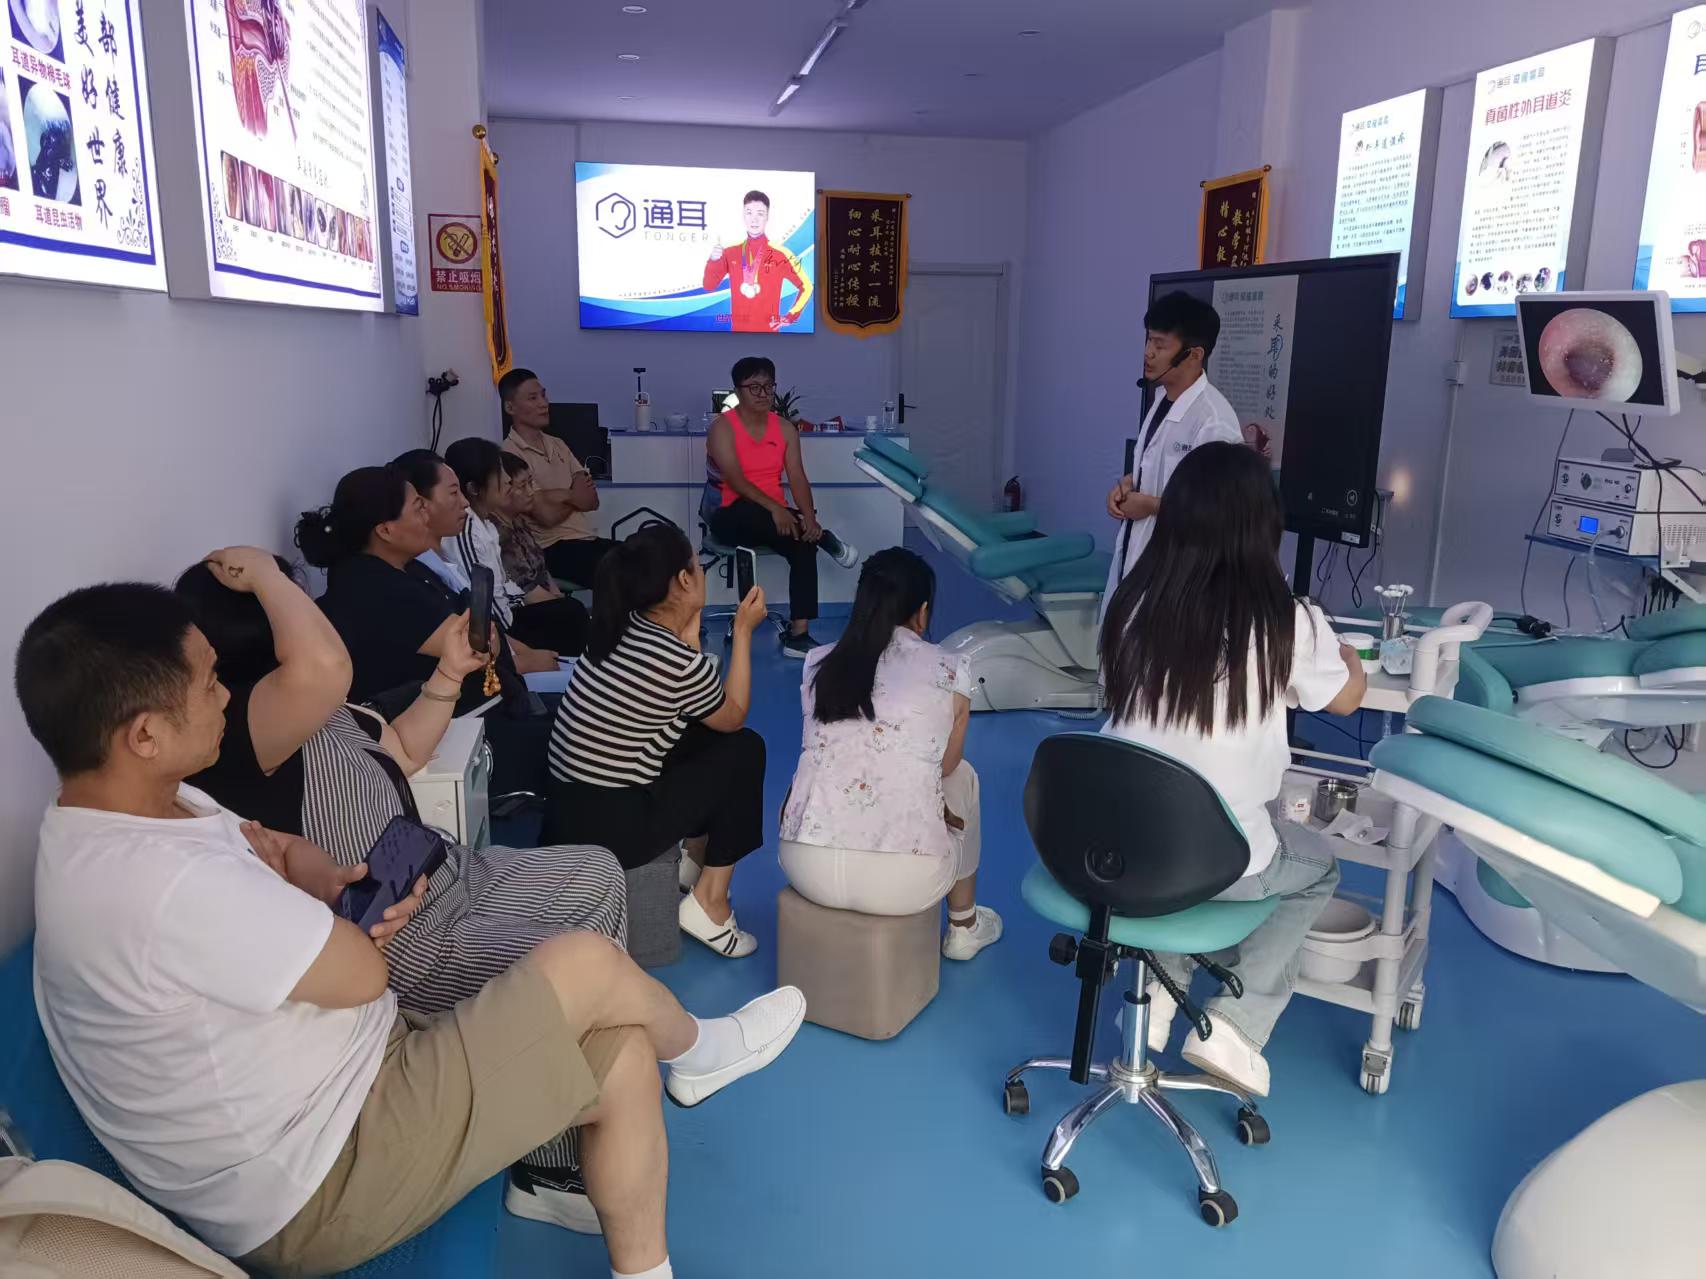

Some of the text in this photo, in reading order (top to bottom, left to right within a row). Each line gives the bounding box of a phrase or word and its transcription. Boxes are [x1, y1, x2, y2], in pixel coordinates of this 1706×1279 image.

[98, 0, 127, 178] 部健康
[643, 198, 708, 231] 通耳
[436, 270, 481, 284] 禁止吸烟
